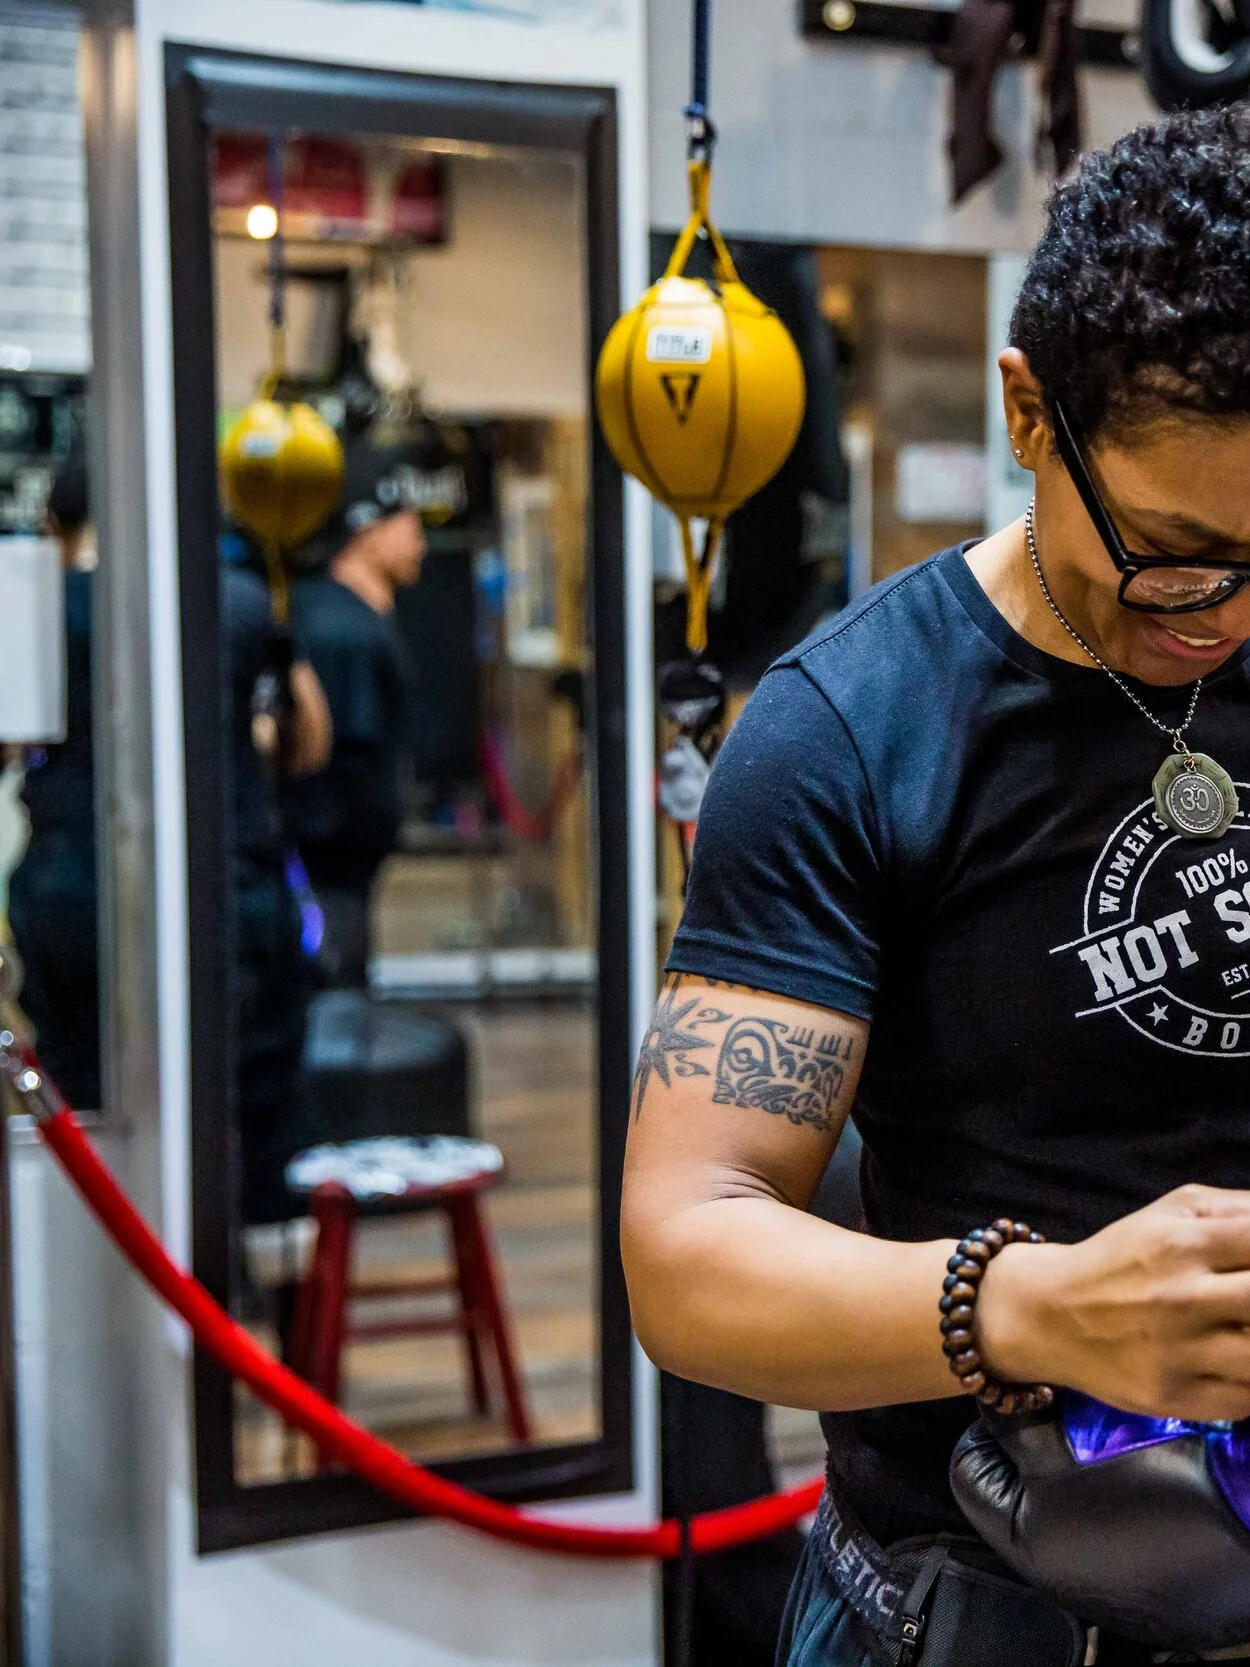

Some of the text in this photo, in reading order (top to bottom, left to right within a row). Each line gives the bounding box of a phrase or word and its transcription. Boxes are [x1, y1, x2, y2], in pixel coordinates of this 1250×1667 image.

[1098, 811, 1168, 915] WOMEN'S
[1175, 848, 1248, 898] 100%
[1078, 909, 1199, 1001] NOT
